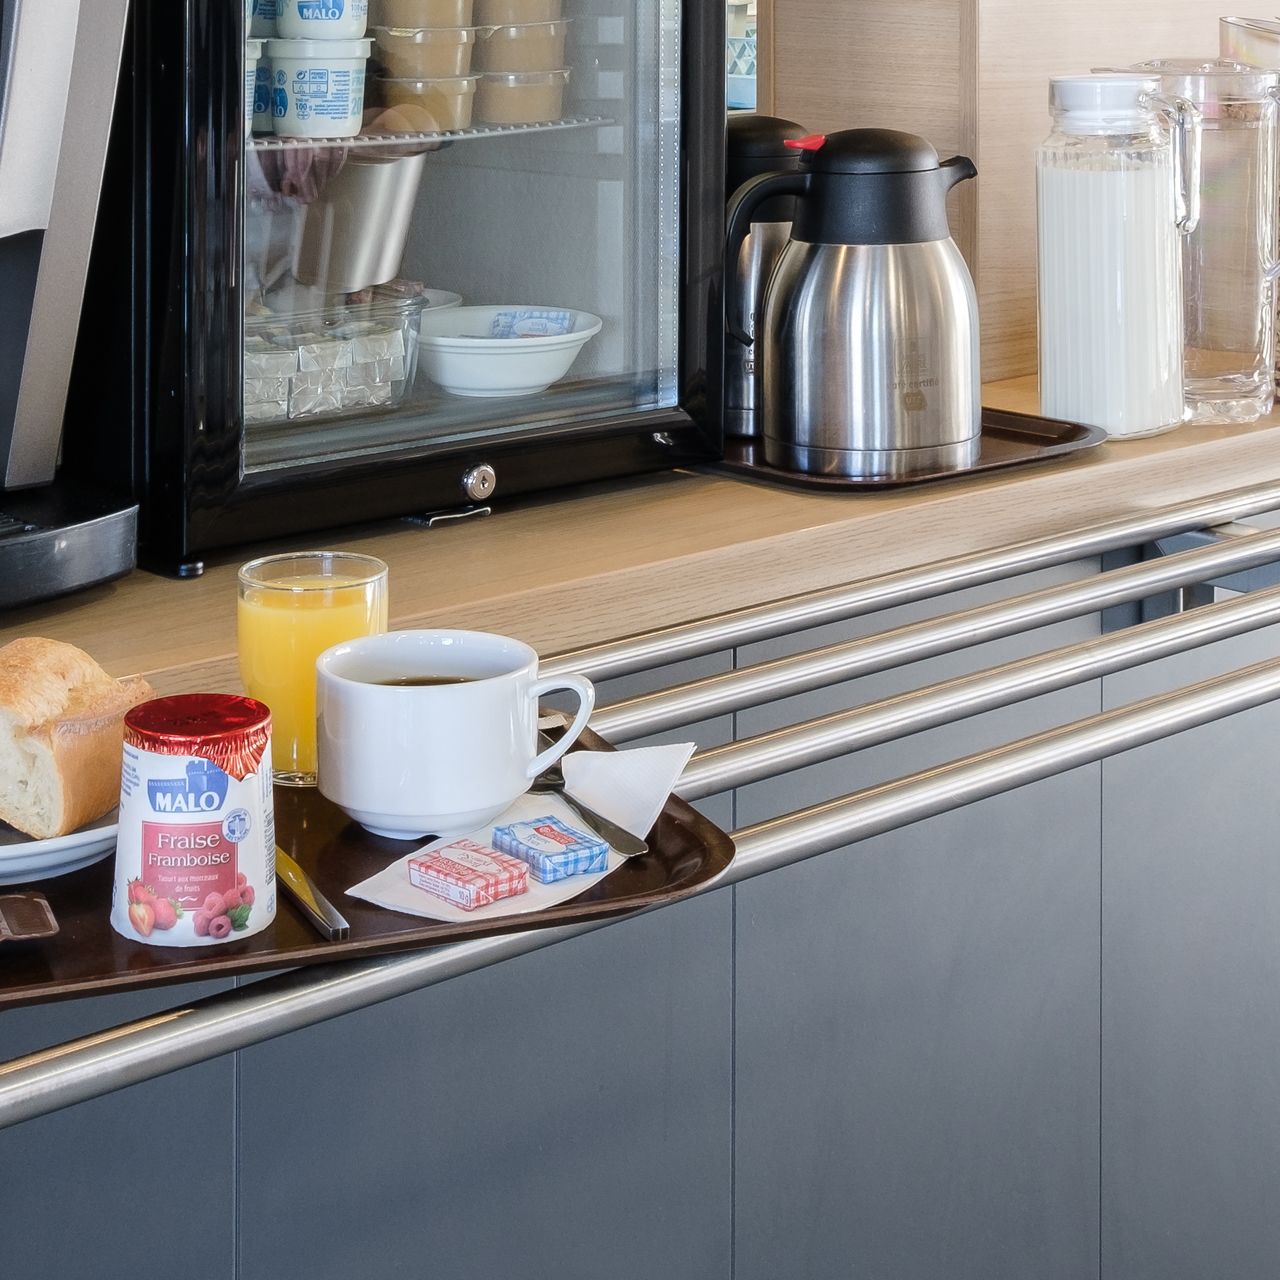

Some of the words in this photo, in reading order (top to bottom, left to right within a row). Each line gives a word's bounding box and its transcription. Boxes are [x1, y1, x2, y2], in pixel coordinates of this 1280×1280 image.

[302, 7, 340, 20] MALO
[156, 791, 220, 811] MALO
[157, 832, 220, 849] Fraise
[148, 852, 231, 867] Framboise
